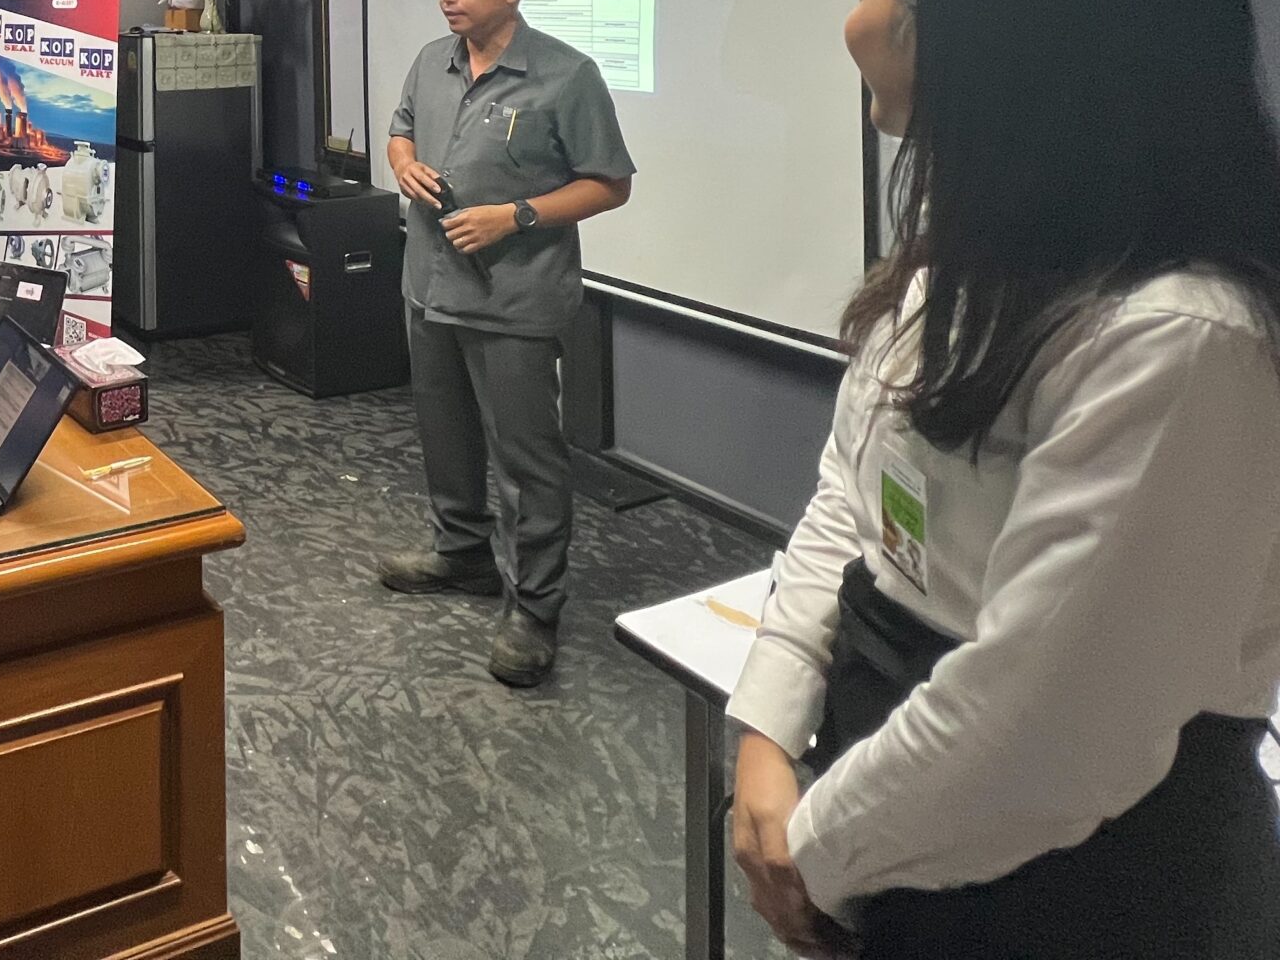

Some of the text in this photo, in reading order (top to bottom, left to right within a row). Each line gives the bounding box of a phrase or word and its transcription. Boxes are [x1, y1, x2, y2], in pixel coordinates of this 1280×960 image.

[5, 28, 34, 41] KOP
[41, 41, 73, 54] KOP
[40, 58, 74, 66] VACUUM
[80, 53, 113, 66] KOP
[80, 70, 112, 78] PART
